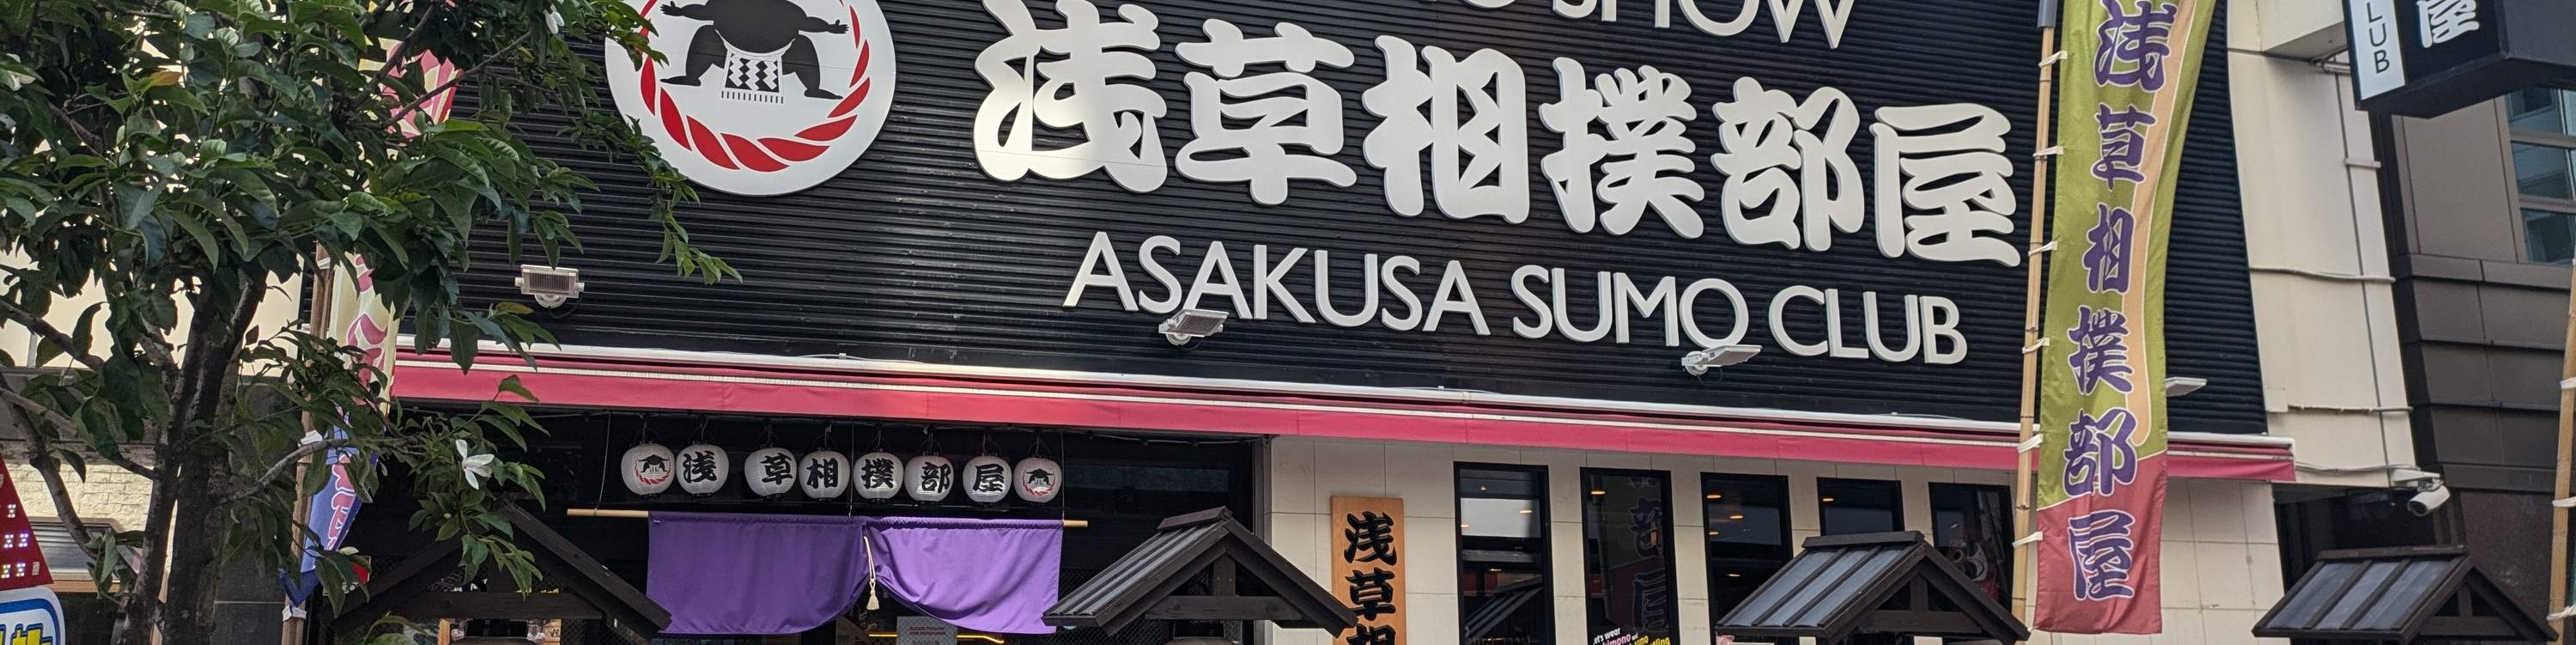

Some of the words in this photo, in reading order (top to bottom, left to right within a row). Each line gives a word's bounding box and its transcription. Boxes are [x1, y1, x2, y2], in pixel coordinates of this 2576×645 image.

[2416, 0, 2480, 48] 屋
[974, 0, 2020, 267] 浅草相撲部屋
[1062, 231, 1491, 336] ASAKUSA
[1510, 264, 1750, 347] SUMO
[1769, 284, 1968, 365] CLUB
[2063, 0, 2178, 602] 浅草相撲部屋
[683, 450, 1005, 494] 浅草相撲部屋
[1593, 635, 1604, 645] et's
